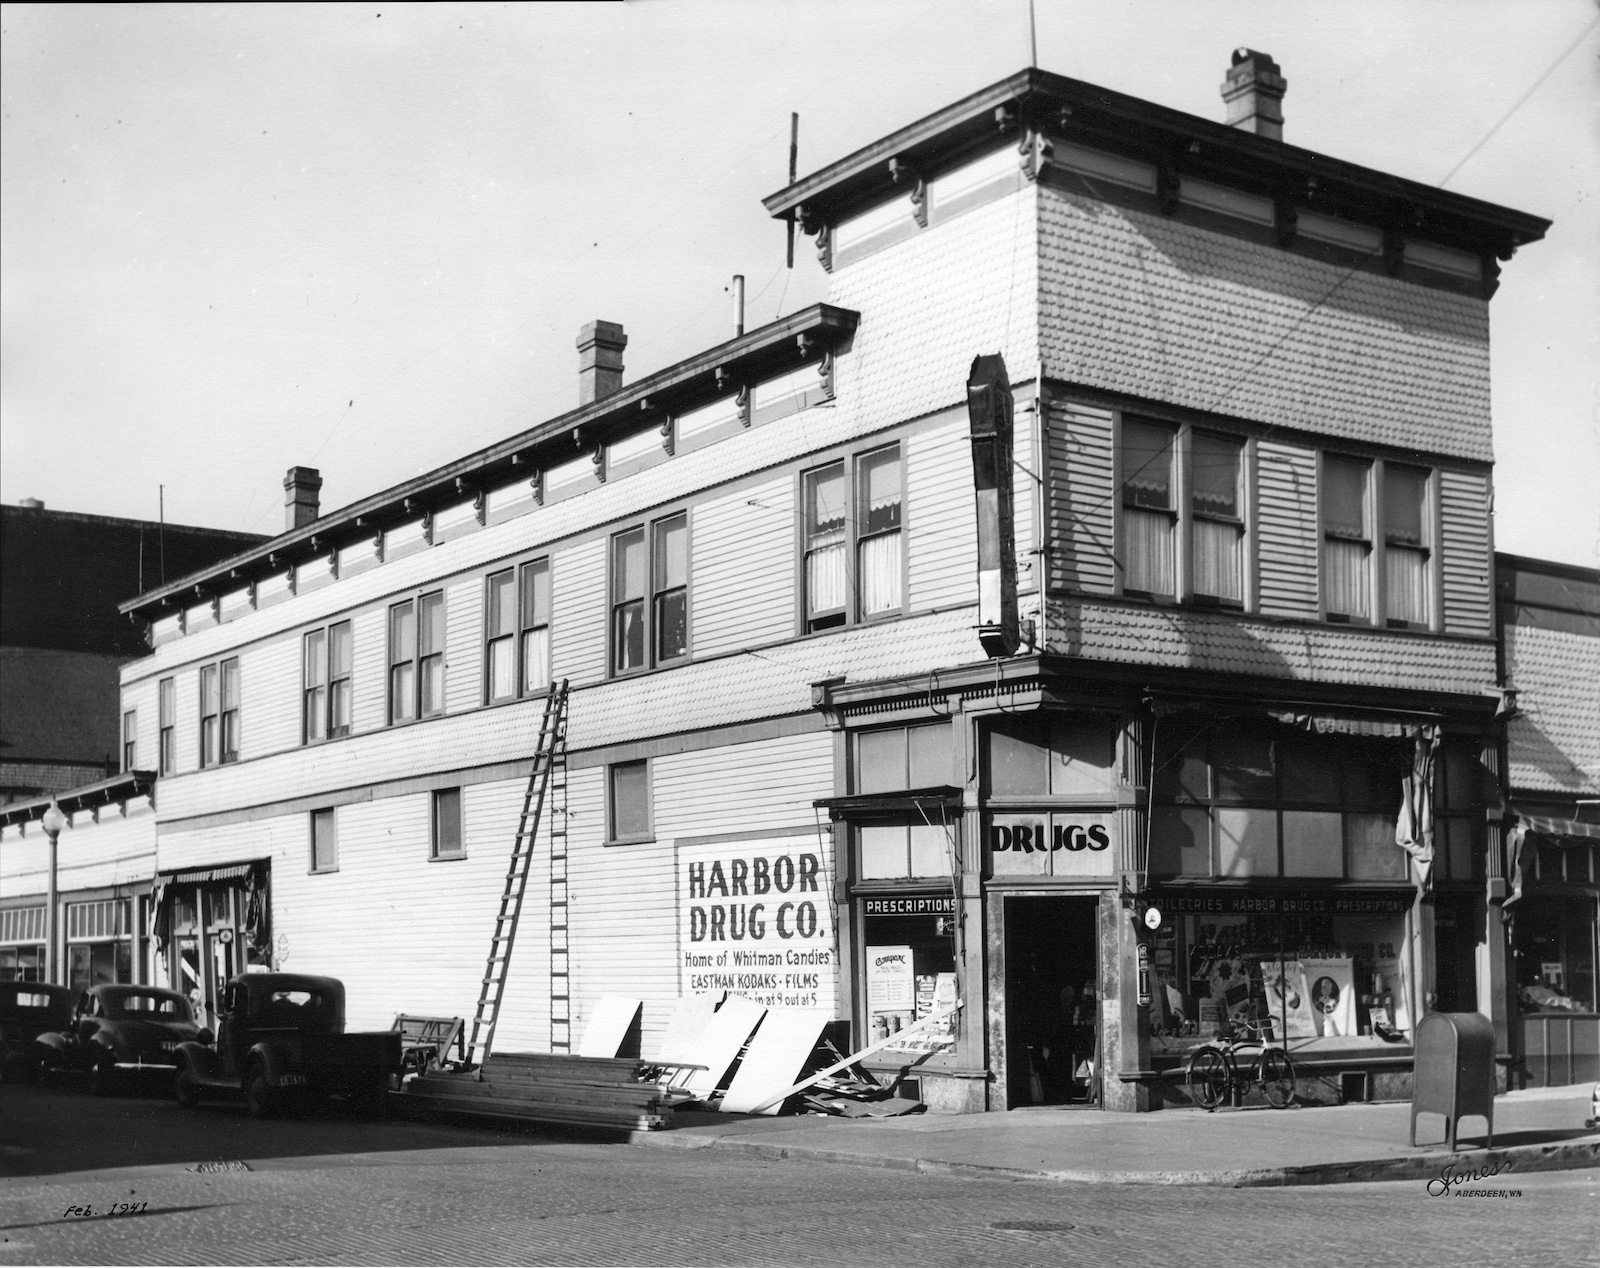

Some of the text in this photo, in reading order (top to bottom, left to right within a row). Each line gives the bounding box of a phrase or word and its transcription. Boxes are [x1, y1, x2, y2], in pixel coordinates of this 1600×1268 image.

[991, 824, 1109, 853] DRUGS
[689, 853, 819, 898] HARBOR
[867, 899, 956, 912] PRESCRIPTIONS
[1232, 899, 1276, 911] HARBOR
[1282, 900, 1310, 911] DRUG
[690, 901, 825, 942] DRUG CO.
[685, 949, 830, 967] Home of Whitman Candies
[691, 974, 735, 989] EASTMAN
[785, 973, 819, 989] FILMS
[766, 993, 775, 1006] at
[777, 993, 783, 1006] 9
[785, 993, 800, 1006] out
[801, 993, 810, 1006] at
[811, 992, 817, 1006] 5
